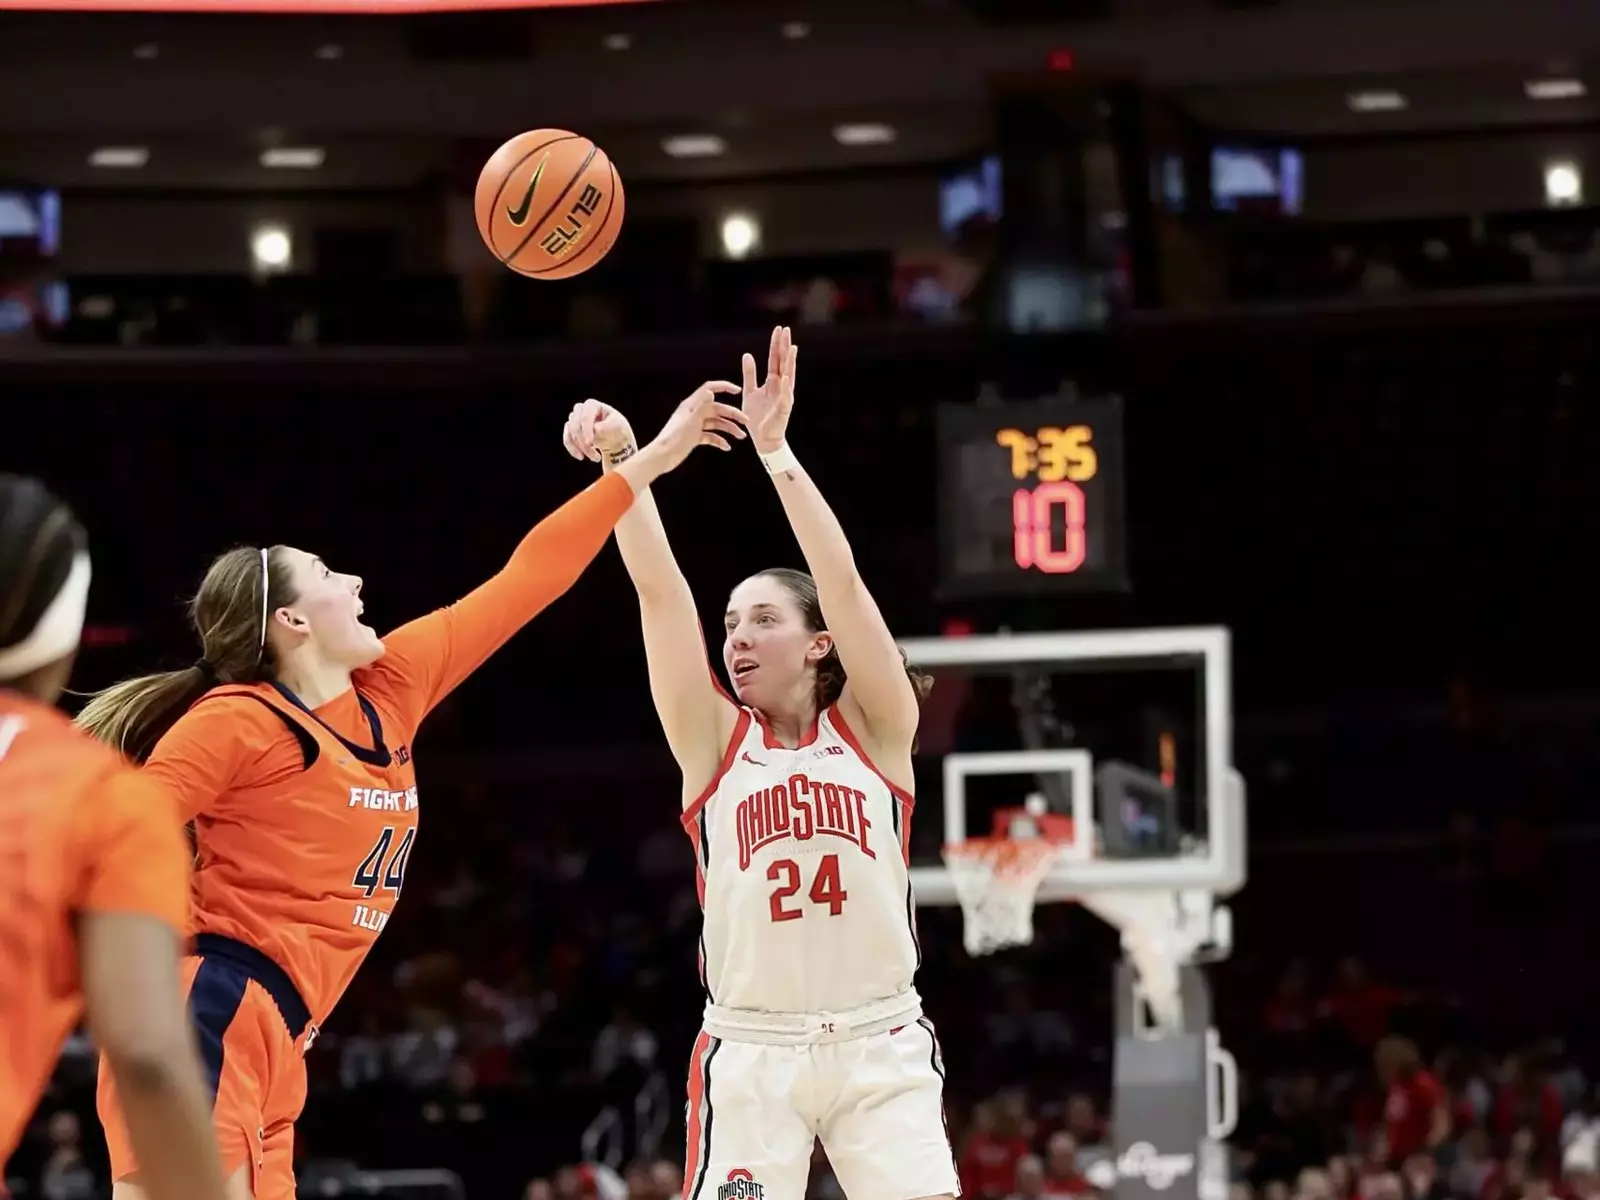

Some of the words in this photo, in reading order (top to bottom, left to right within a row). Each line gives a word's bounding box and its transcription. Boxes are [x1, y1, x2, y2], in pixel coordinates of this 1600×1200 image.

[540, 183, 602, 255] ELITE
[996, 424, 1097, 482] 7:35
[1013, 480, 1086, 574] 10
[351, 826, 417, 901] 44
[766, 854, 847, 922] 24
